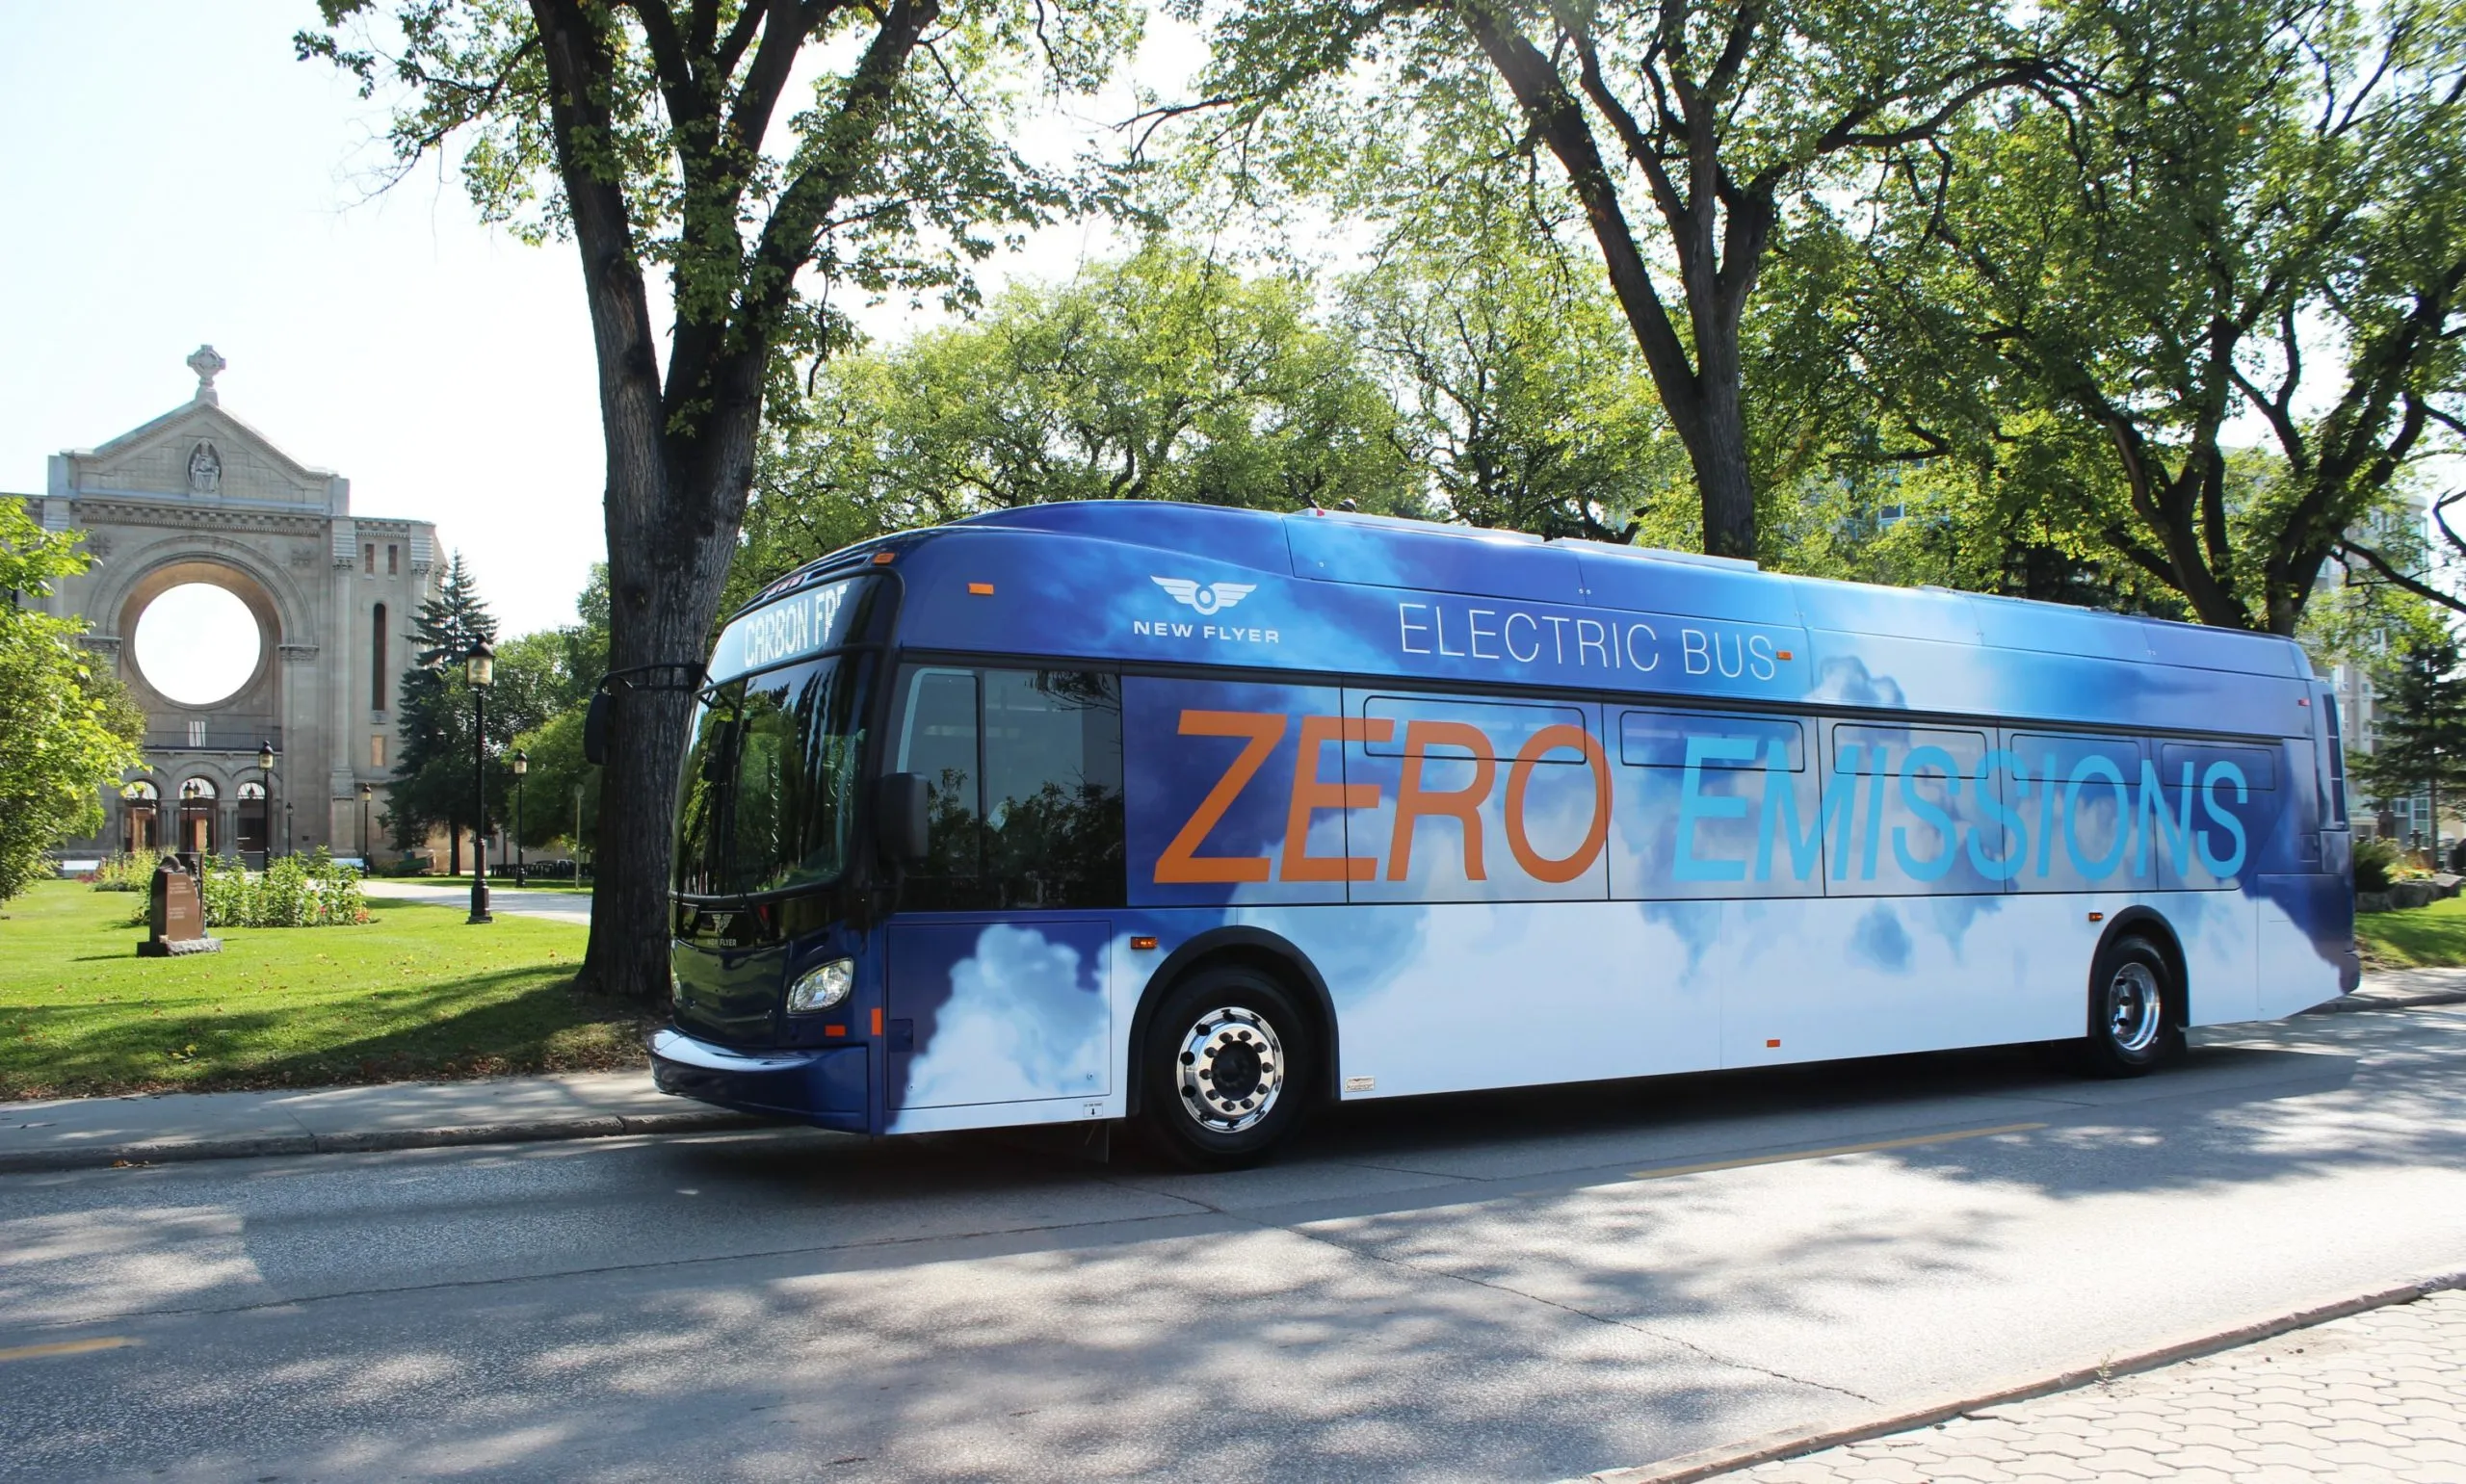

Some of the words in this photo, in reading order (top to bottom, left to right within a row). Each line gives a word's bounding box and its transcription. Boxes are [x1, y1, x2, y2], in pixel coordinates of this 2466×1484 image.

[745, 598, 808, 667] CARBON
[814, 581, 850, 646] FR
[1133, 620, 1194, 638] NEW
[1203, 625, 1280, 644] FLYER
[1399, 603, 1659, 672] ELECTRIC
[1681, 628, 1775, 681] BUS
[1153, 710, 1613, 885] ZERO
[1672, 736, 2248, 883] EMISSIONS
[720, 938, 738, 948] FLYER
